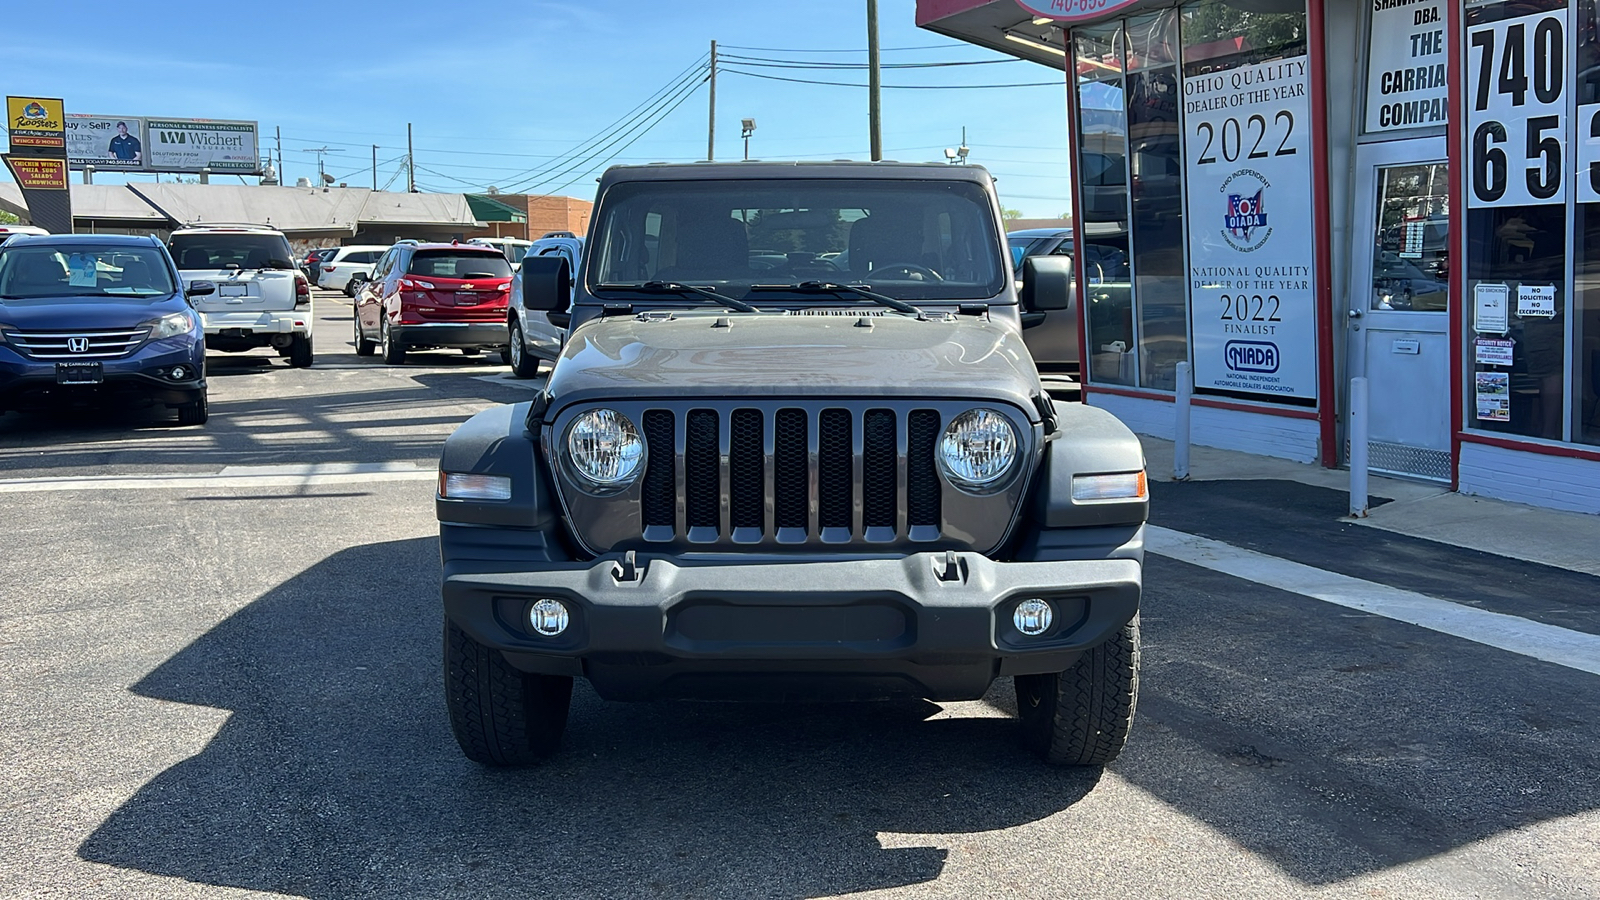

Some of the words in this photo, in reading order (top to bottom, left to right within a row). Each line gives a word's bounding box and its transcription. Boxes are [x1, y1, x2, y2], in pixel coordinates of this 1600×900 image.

[1375, 0, 1415, 11] SHA
[1414, 6, 1441, 26] DBA.
[1410, 29, 1443, 58] THE
[1471, 16, 1563, 112] 740
[1185, 76, 1224, 96] OHIO
[1231, 60, 1306, 90] QUALITY
[1381, 63, 1448, 95] CARRIA
[1187, 96, 1228, 114] DEALER
[1230, 92, 1245, 107] OF
[1247, 88, 1271, 104] THE
[1273, 82, 1305, 100] YEAR
[15, 116, 58, 128] Roosters
[89, 121, 111, 130] Sell?
[188, 131, 243, 146] Wichert
[1196, 109, 1298, 166] 2022
[1220, 176, 1232, 193] OHIO
[1231, 169, 1271, 189] INDEPENDENT
[1229, 215, 1260, 228] OIADA
[1193, 266, 1250, 277] NATIONAL
[1255, 266, 1310, 278] QUALITY
[1236, 280, 1250, 290] OF
[1253, 280, 1275, 290] THE
[1279, 280, 1309, 290] YEAR
[1220, 294, 1282, 322] 2022
[1224, 323, 1276, 335] FINALIST
[1228, 346, 1275, 367] NIADA
[1214, 380, 1241, 388] AUTOMOBILE
[1242, 382, 1262, 390] DEALERS
[1262, 384, 1295, 393] ASSOCIATION
[1249, 375, 1280, 383] INDEPENDENT
